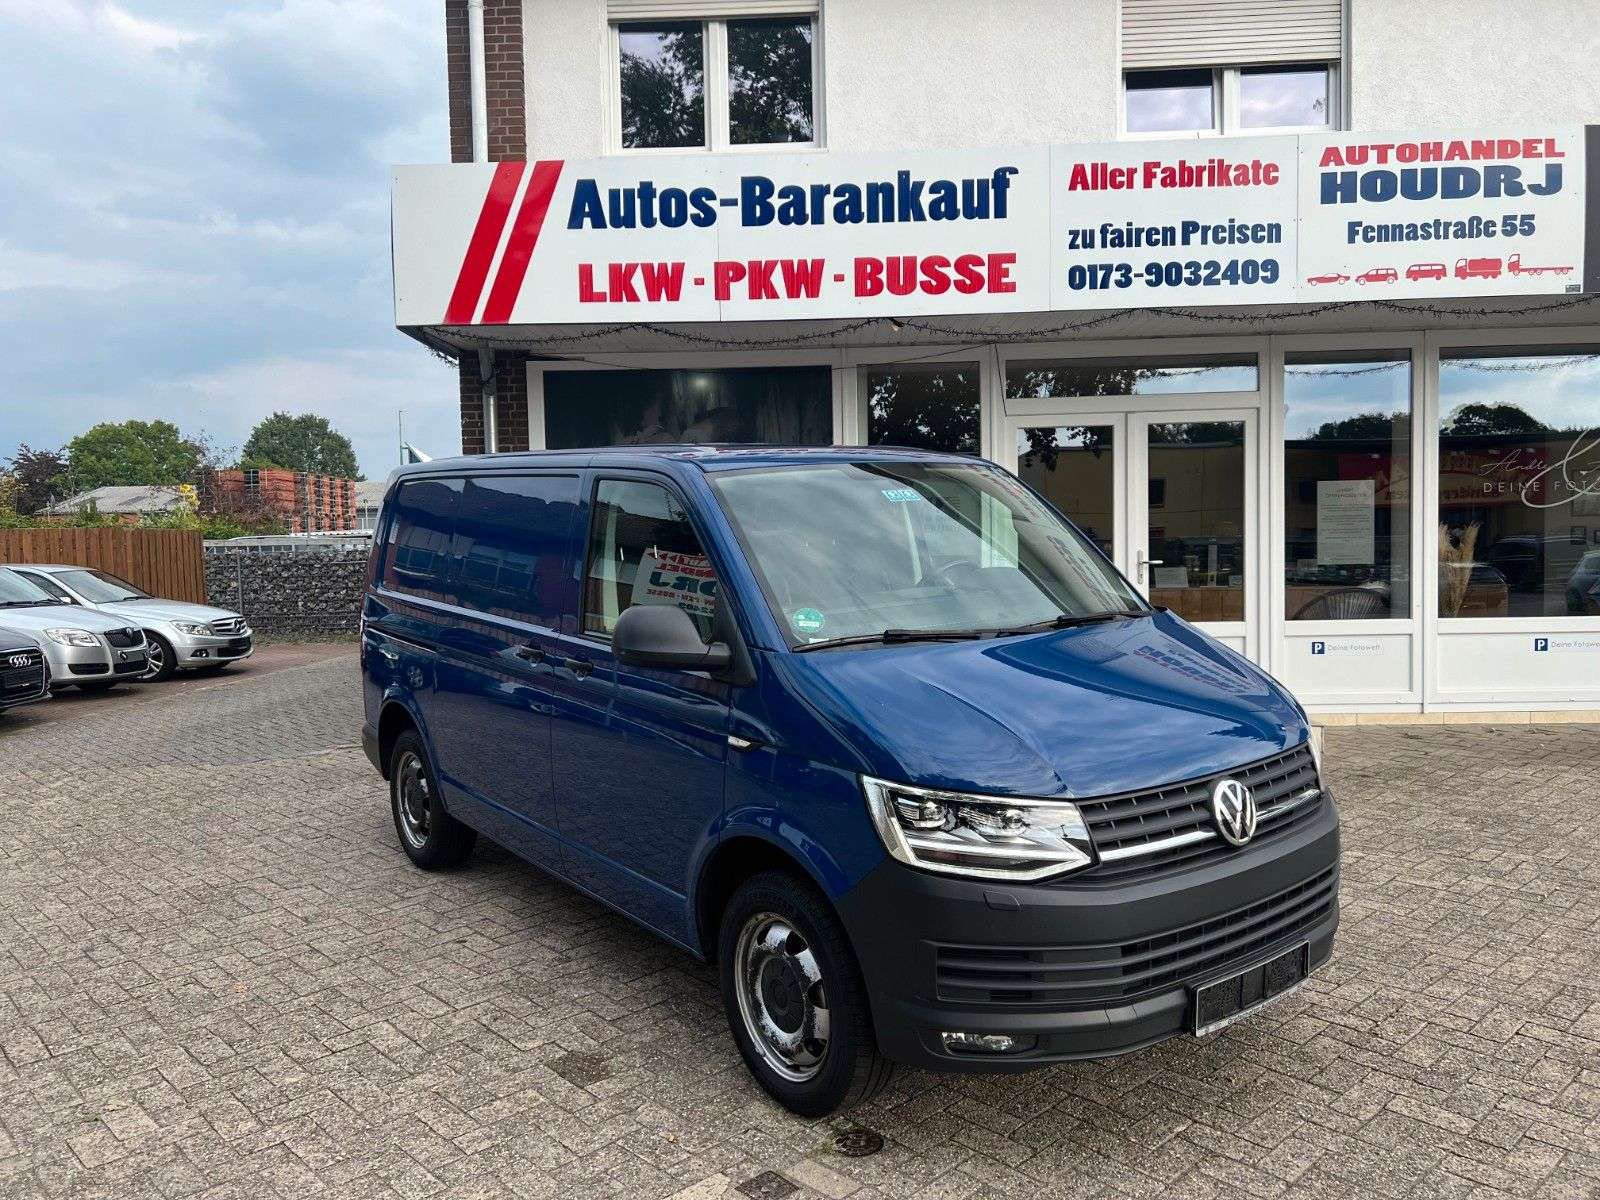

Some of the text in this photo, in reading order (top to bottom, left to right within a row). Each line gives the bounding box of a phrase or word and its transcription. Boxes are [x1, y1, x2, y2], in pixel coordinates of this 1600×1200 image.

[1319, 138, 1565, 168] AUTOHANDEL
[1068, 158, 1280, 192] Aller Fabrikate
[1319, 163, 1564, 205] HOUDRJ
[567, 167, 1019, 229] Autos-Barankauf
[1068, 218, 1282, 250] zu fairen Preisen
[1347, 213, 1536, 245] Fennastraße 55
[578, 262, 686, 303] LKW
[714, 258, 826, 301] PKW
[853, 253, 1017, 298] BUSSE
[1067, 258, 1280, 291] 0173-9032409
